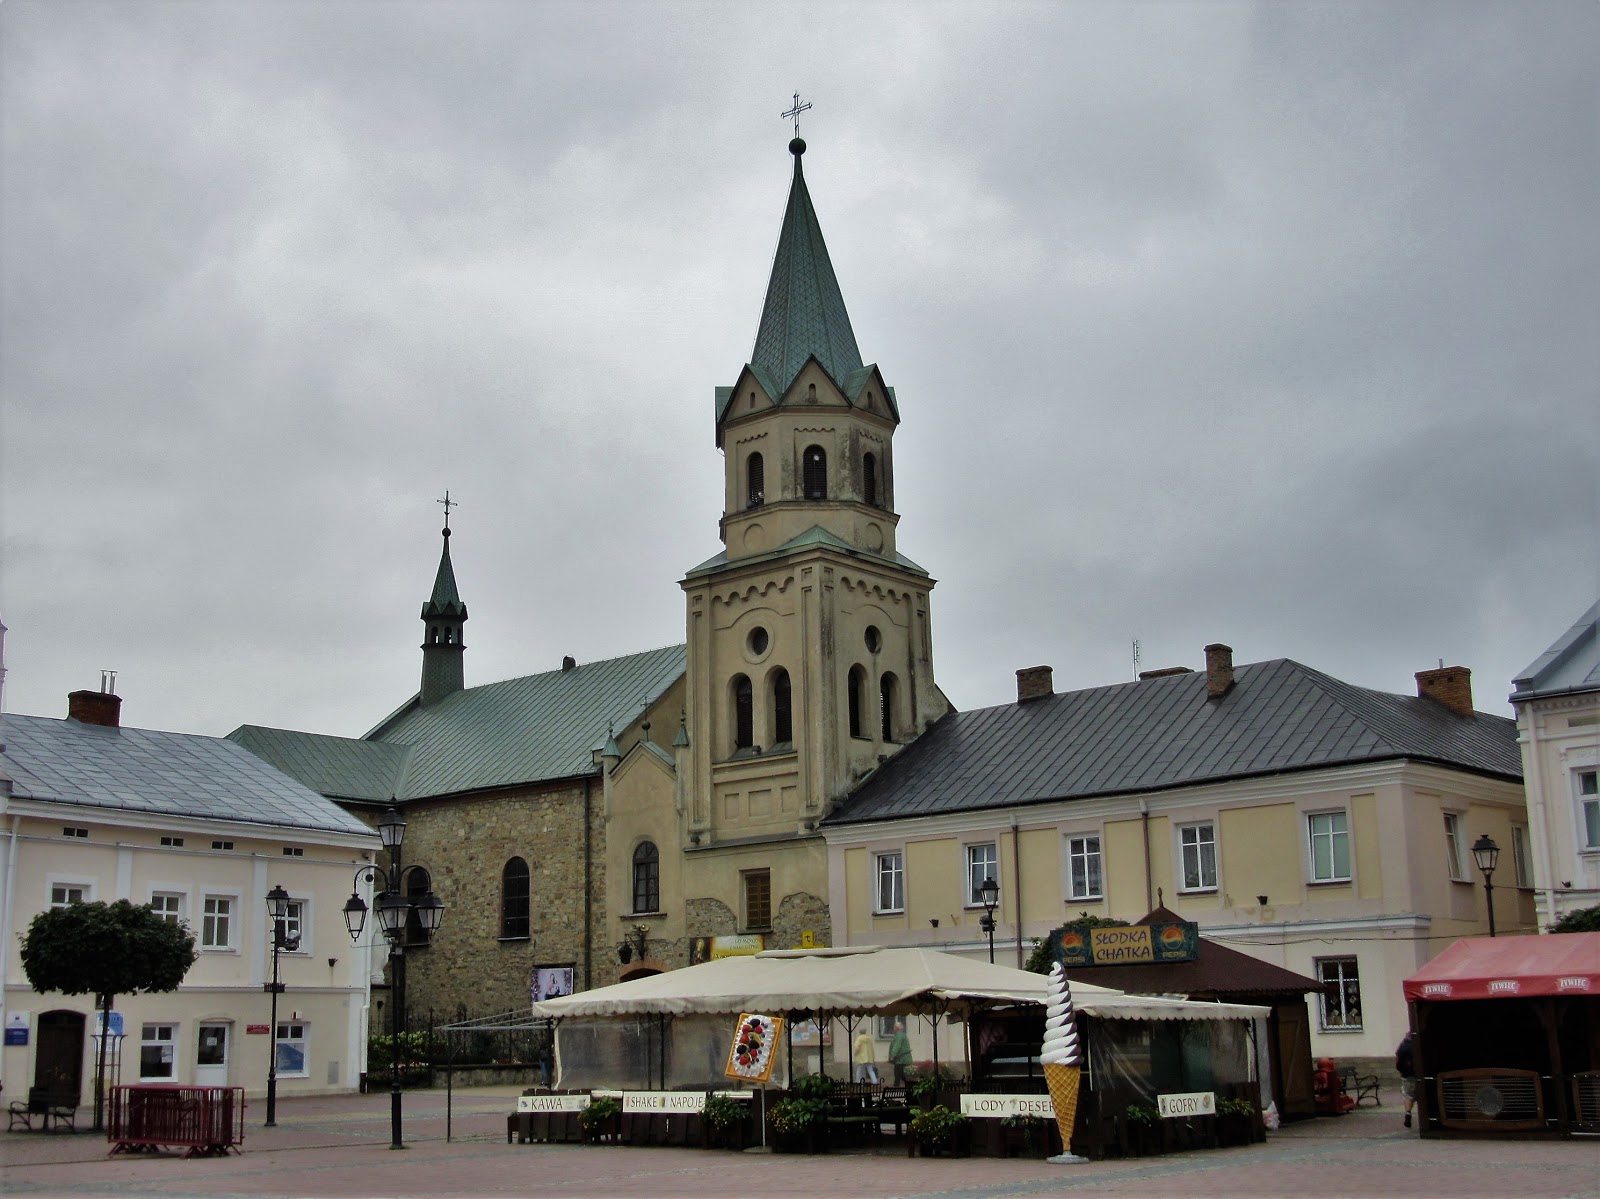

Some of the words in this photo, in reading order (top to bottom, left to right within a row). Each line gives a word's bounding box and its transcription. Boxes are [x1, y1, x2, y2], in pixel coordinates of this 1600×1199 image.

[1095, 930, 1147, 945] SŁODKA
[1096, 946, 1150, 960] CHATKA
[531, 1097, 563, 1110] KAWA
[630, 1096, 658, 1108] SHAKE
[669, 1097, 703, 1108] NAPOJE
[974, 1100, 1006, 1112] LODY
[1169, 1098, 1199, 1113] GOFRY
